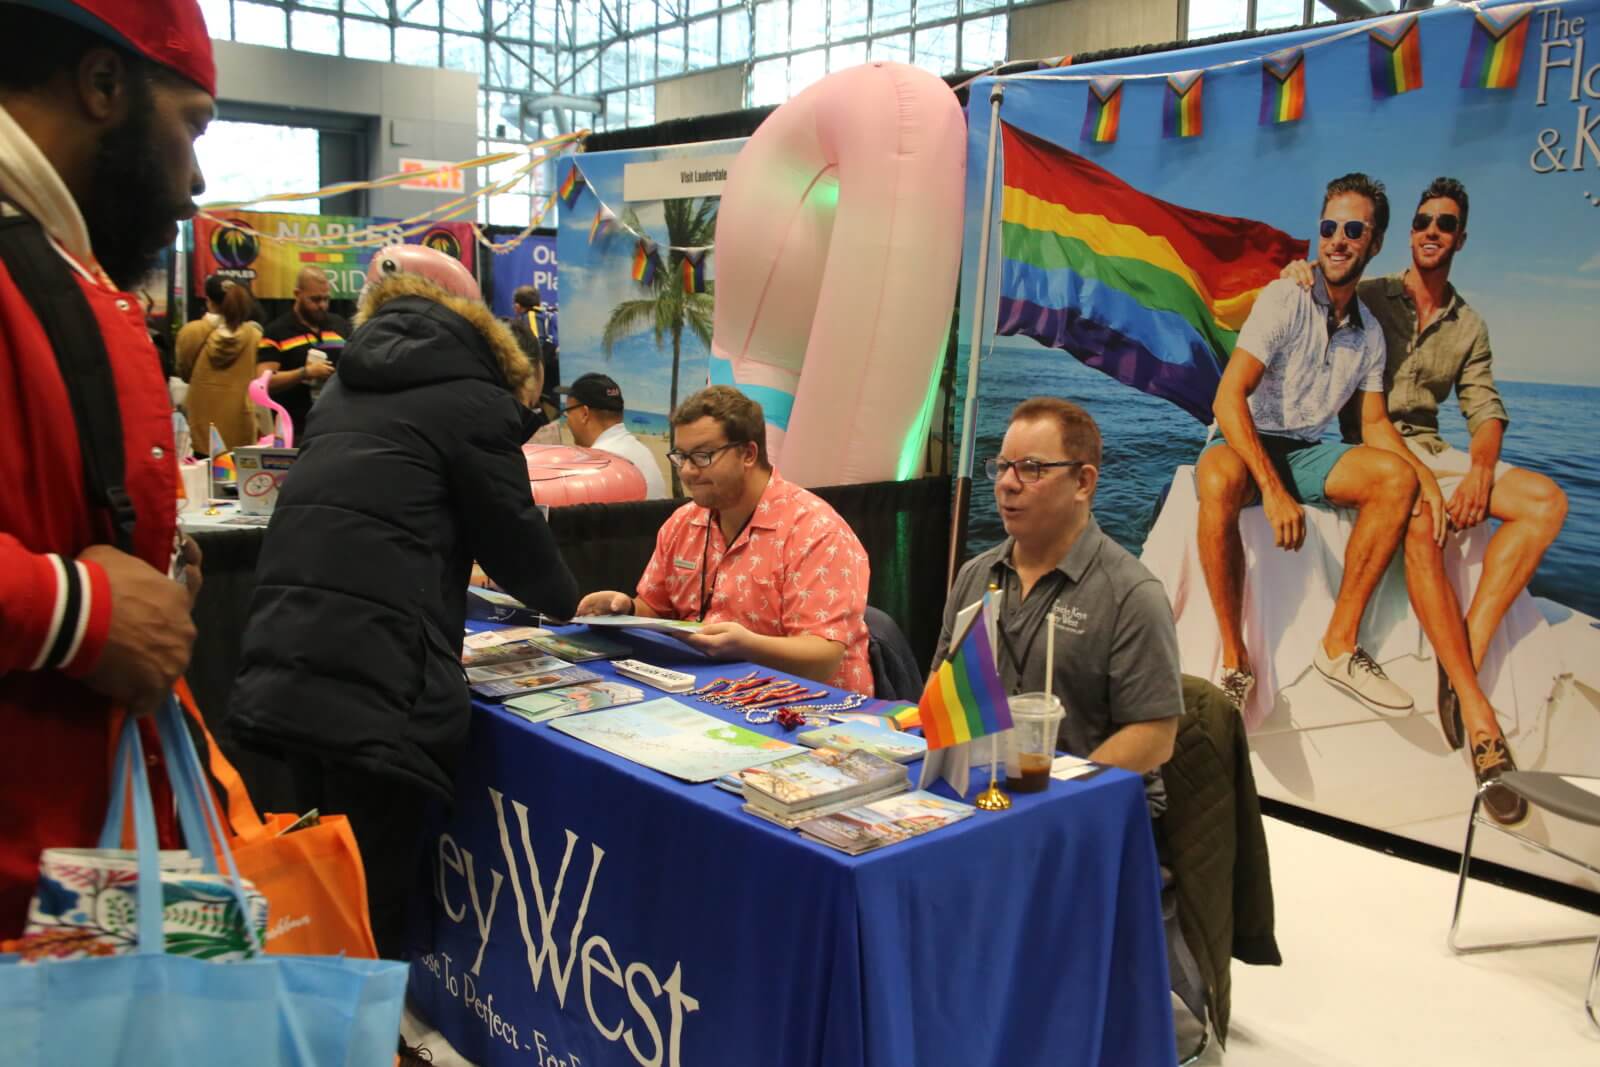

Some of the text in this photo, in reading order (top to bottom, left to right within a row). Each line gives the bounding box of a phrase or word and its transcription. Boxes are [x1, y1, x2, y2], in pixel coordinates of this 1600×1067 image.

[1537, 8, 1585, 41] The
[680, 168, 728, 184] Visit Lauderdale
[277, 221, 405, 248] NAPLES
[324, 269, 367, 294] RID
[439, 786, 700, 1067] ey West
[441, 952, 459, 997] To
[464, 972, 520, 1051] Perfect
